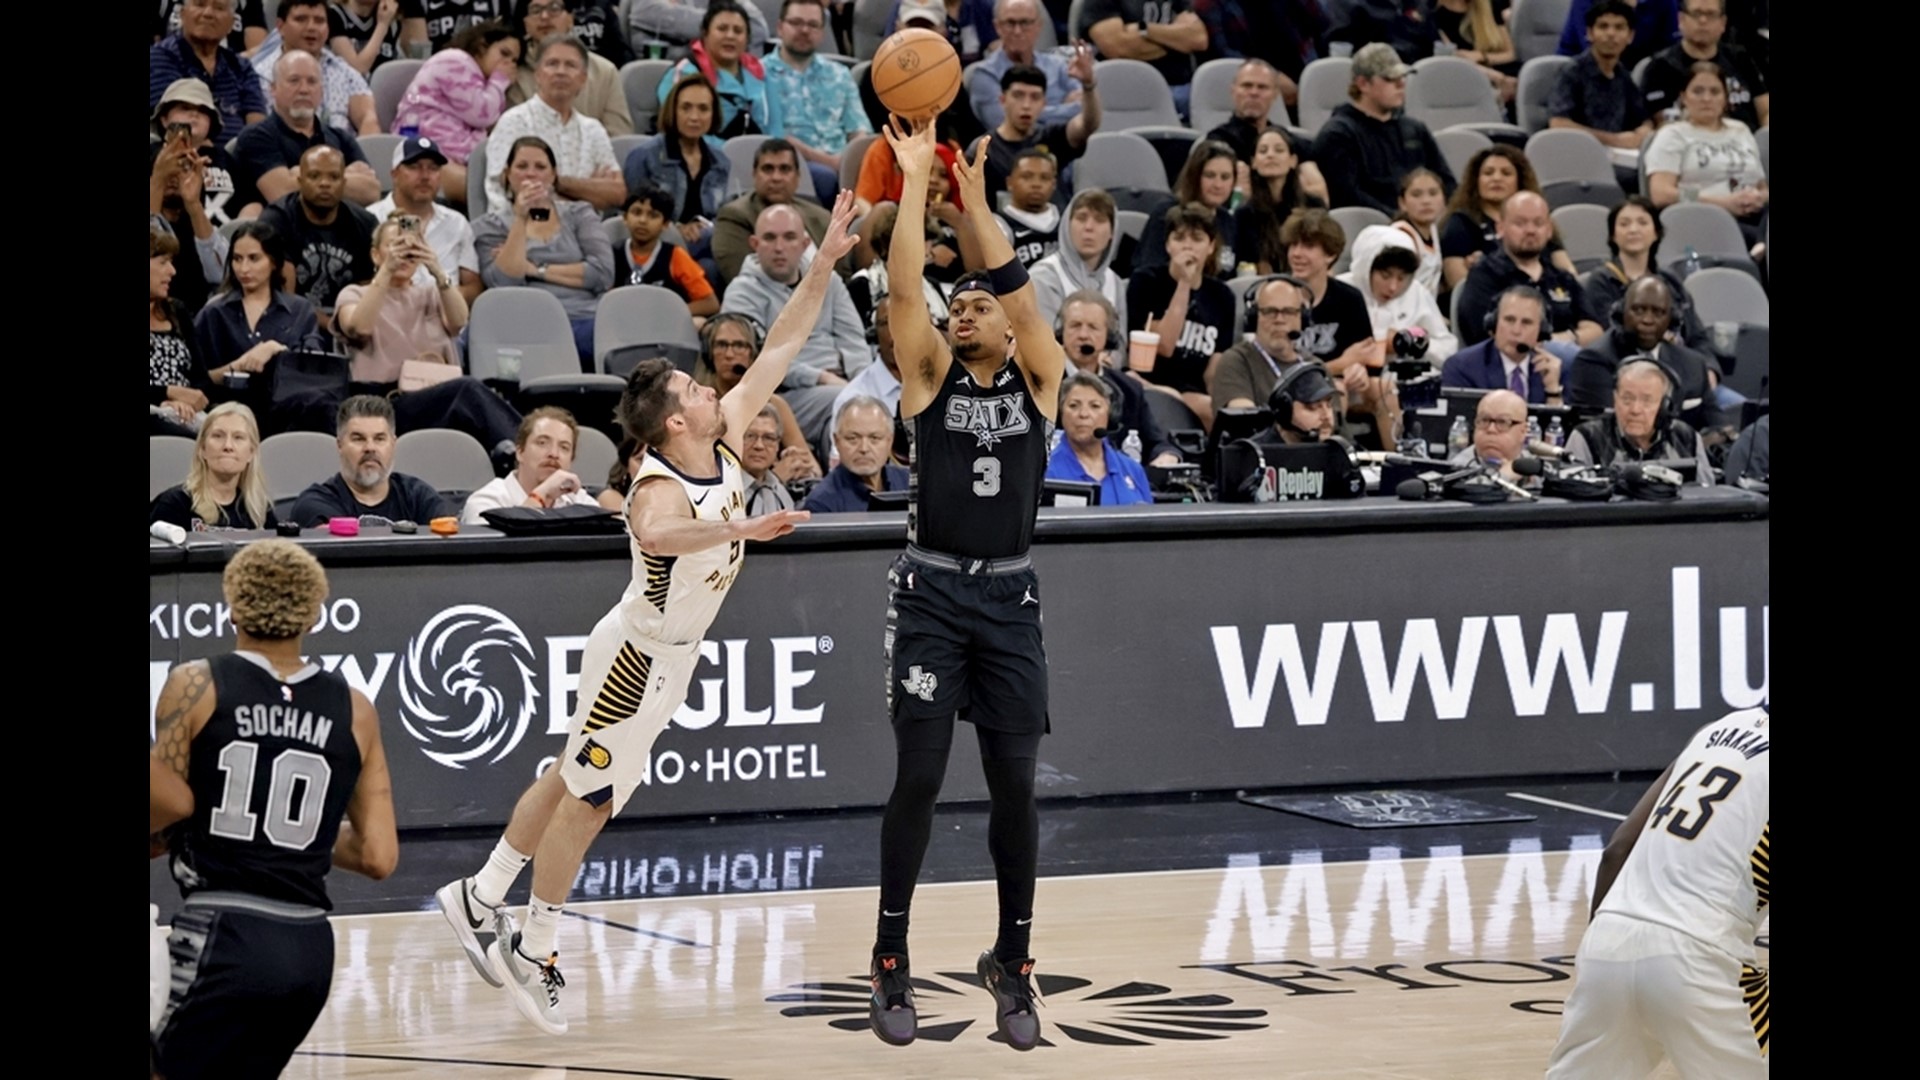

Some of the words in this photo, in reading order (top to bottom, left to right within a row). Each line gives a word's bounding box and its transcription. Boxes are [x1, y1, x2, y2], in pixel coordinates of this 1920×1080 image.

[943, 391, 1032, 439] SATX
[972, 456, 1002, 498] 3
[1278, 466, 1324, 498] Replay
[234, 703, 333, 749] SOCHAN
[706, 744, 826, 782] HOTEL
[209, 740, 332, 850] 10
[1650, 761, 1742, 840] 43
